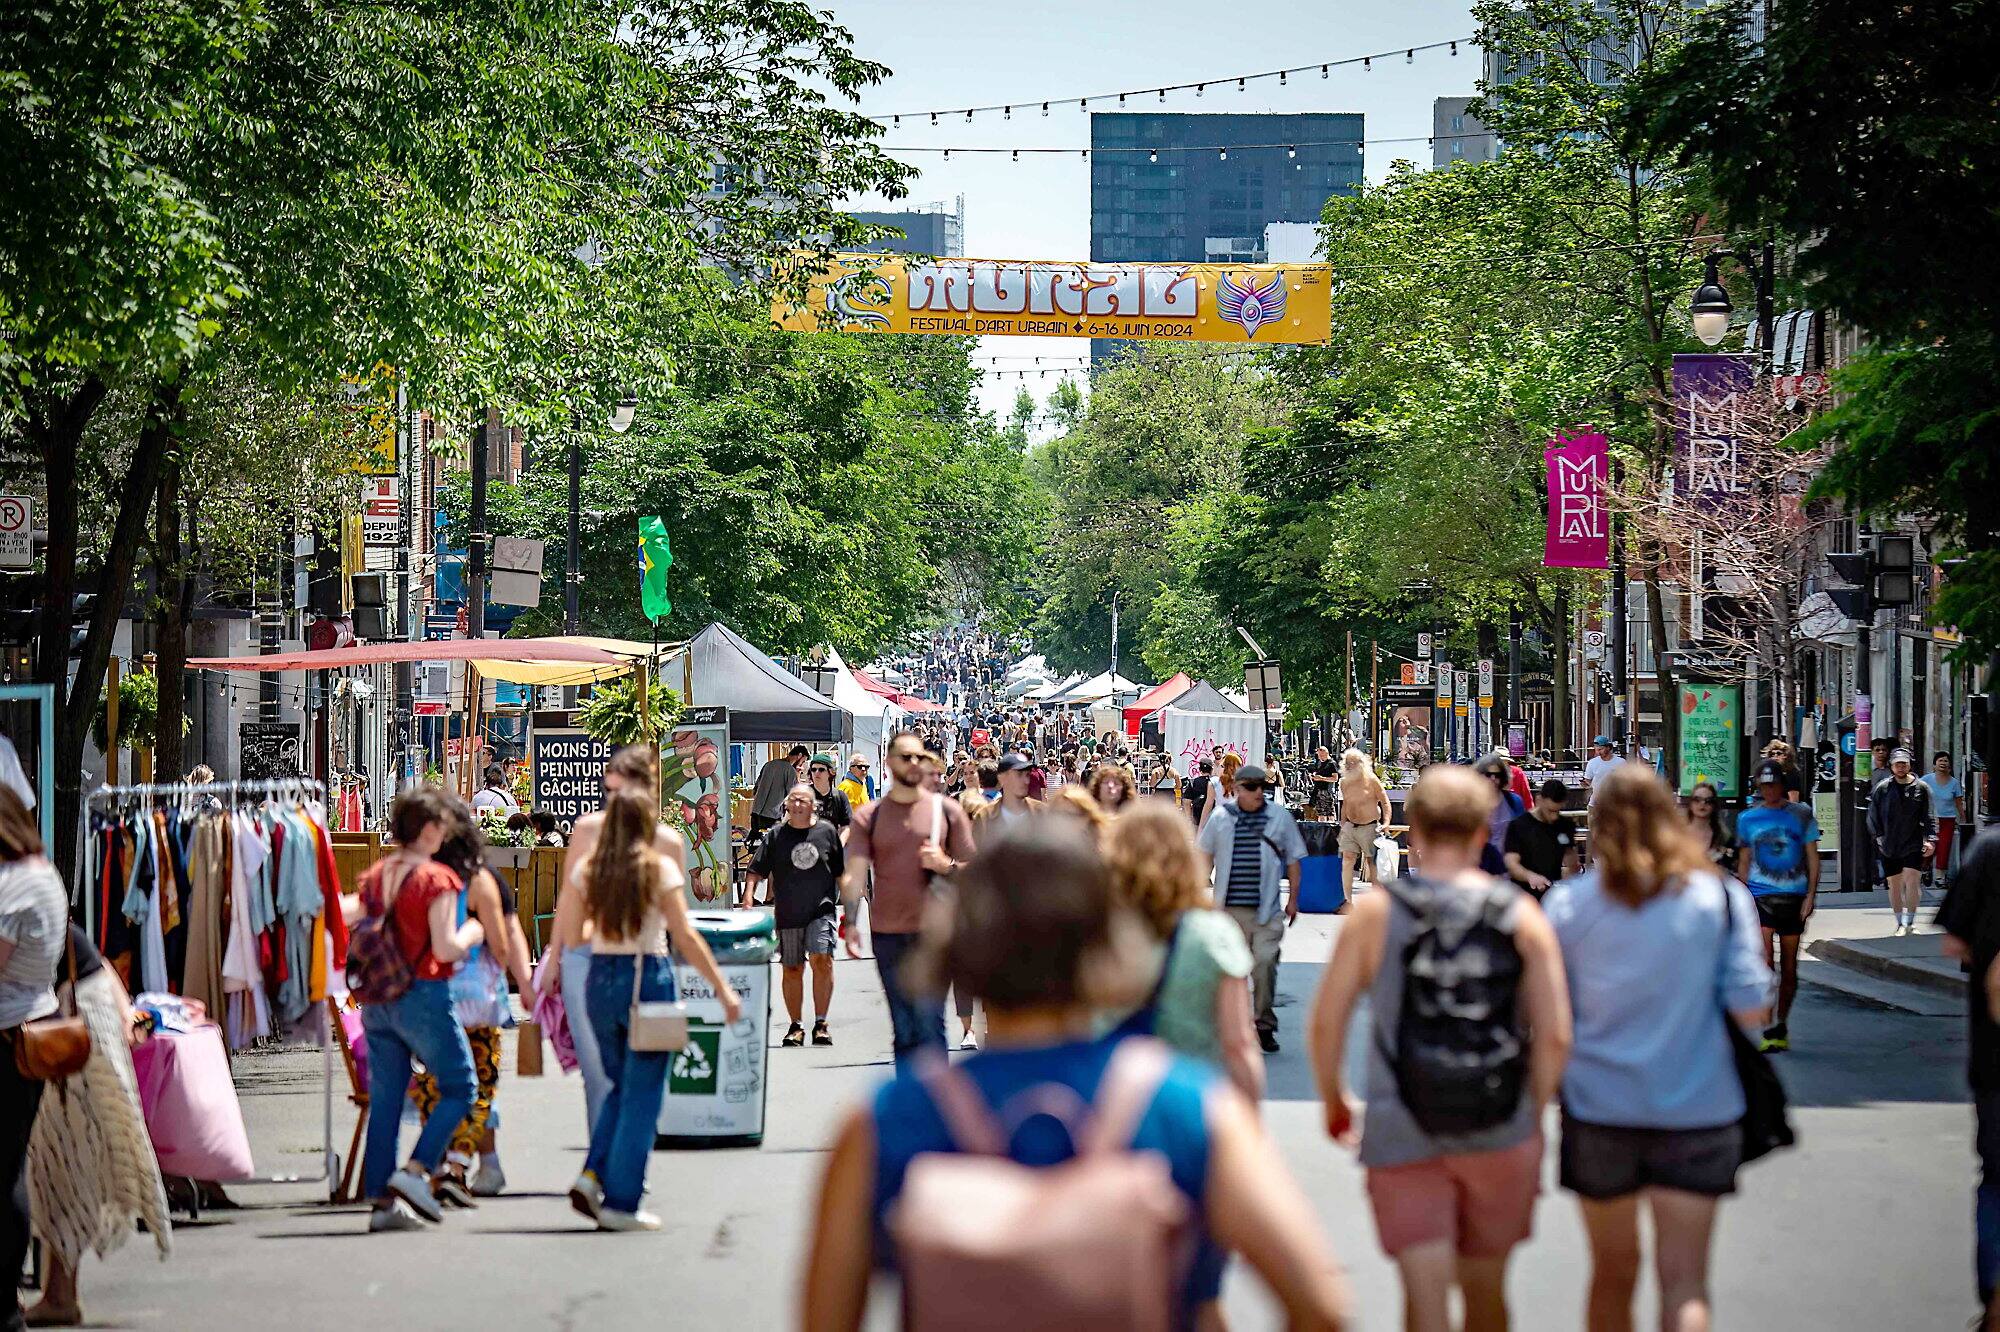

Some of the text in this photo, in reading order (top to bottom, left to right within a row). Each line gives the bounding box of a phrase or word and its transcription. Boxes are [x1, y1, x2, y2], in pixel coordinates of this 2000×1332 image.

[907, 260, 1198, 318] MURAL
[910, 317, 1194, 337] FESTIVAL D'ART URBAIN 6-16 JUIN 2024
[1557, 454, 1605, 538] MURAL
[363, 522, 400, 531] DEPUI
[539, 742, 611, 758] MOINS DE
[540, 777, 603, 798] GÂCHÉE,
[540, 800, 600, 816] PLUS DE
